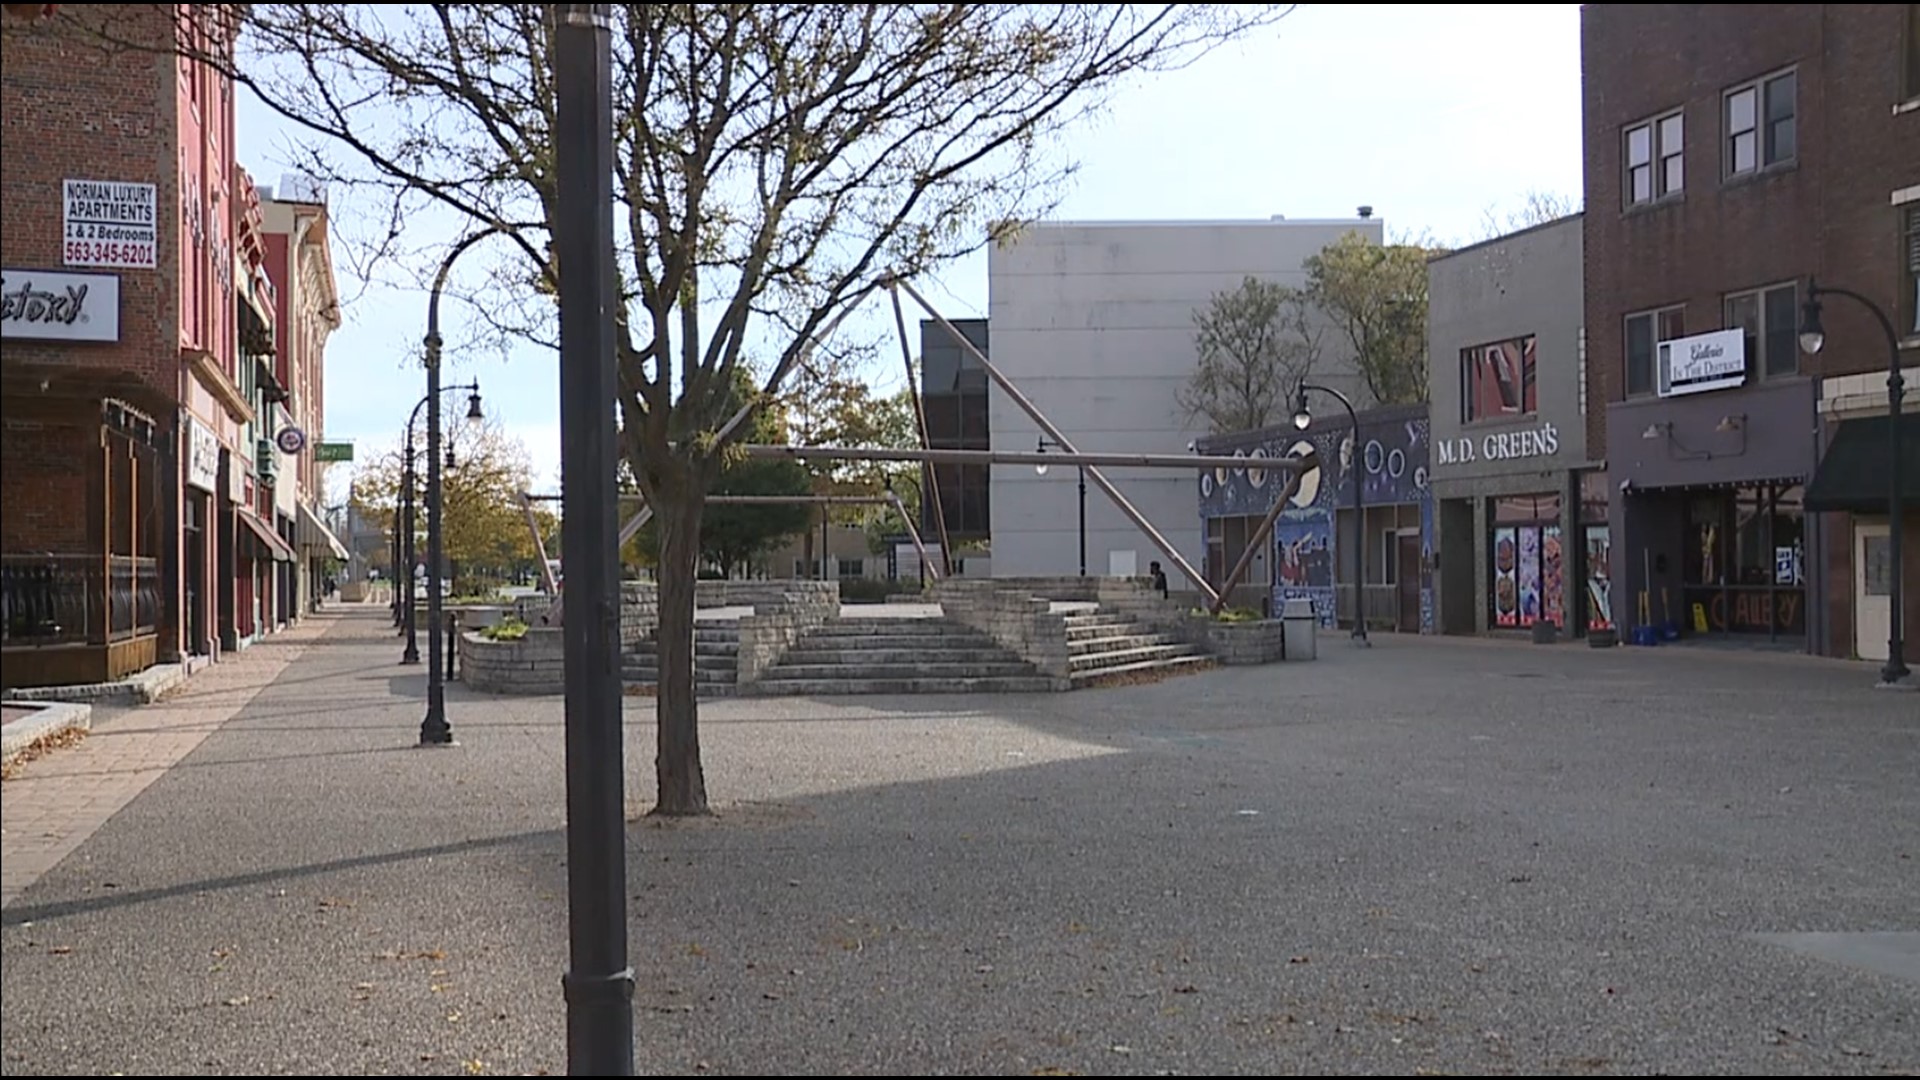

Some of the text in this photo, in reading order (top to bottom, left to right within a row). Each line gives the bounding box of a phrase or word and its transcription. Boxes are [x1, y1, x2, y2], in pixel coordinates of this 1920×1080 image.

[67, 183, 153, 203] NORMAN LUXURY
[68, 200, 153, 221] APARTMENTS
[66, 224, 154, 241] 1 & 2 Bedrooms
[66, 241, 153, 264] 563-345-6201
[1483, 422, 1558, 460] GREEN'S
